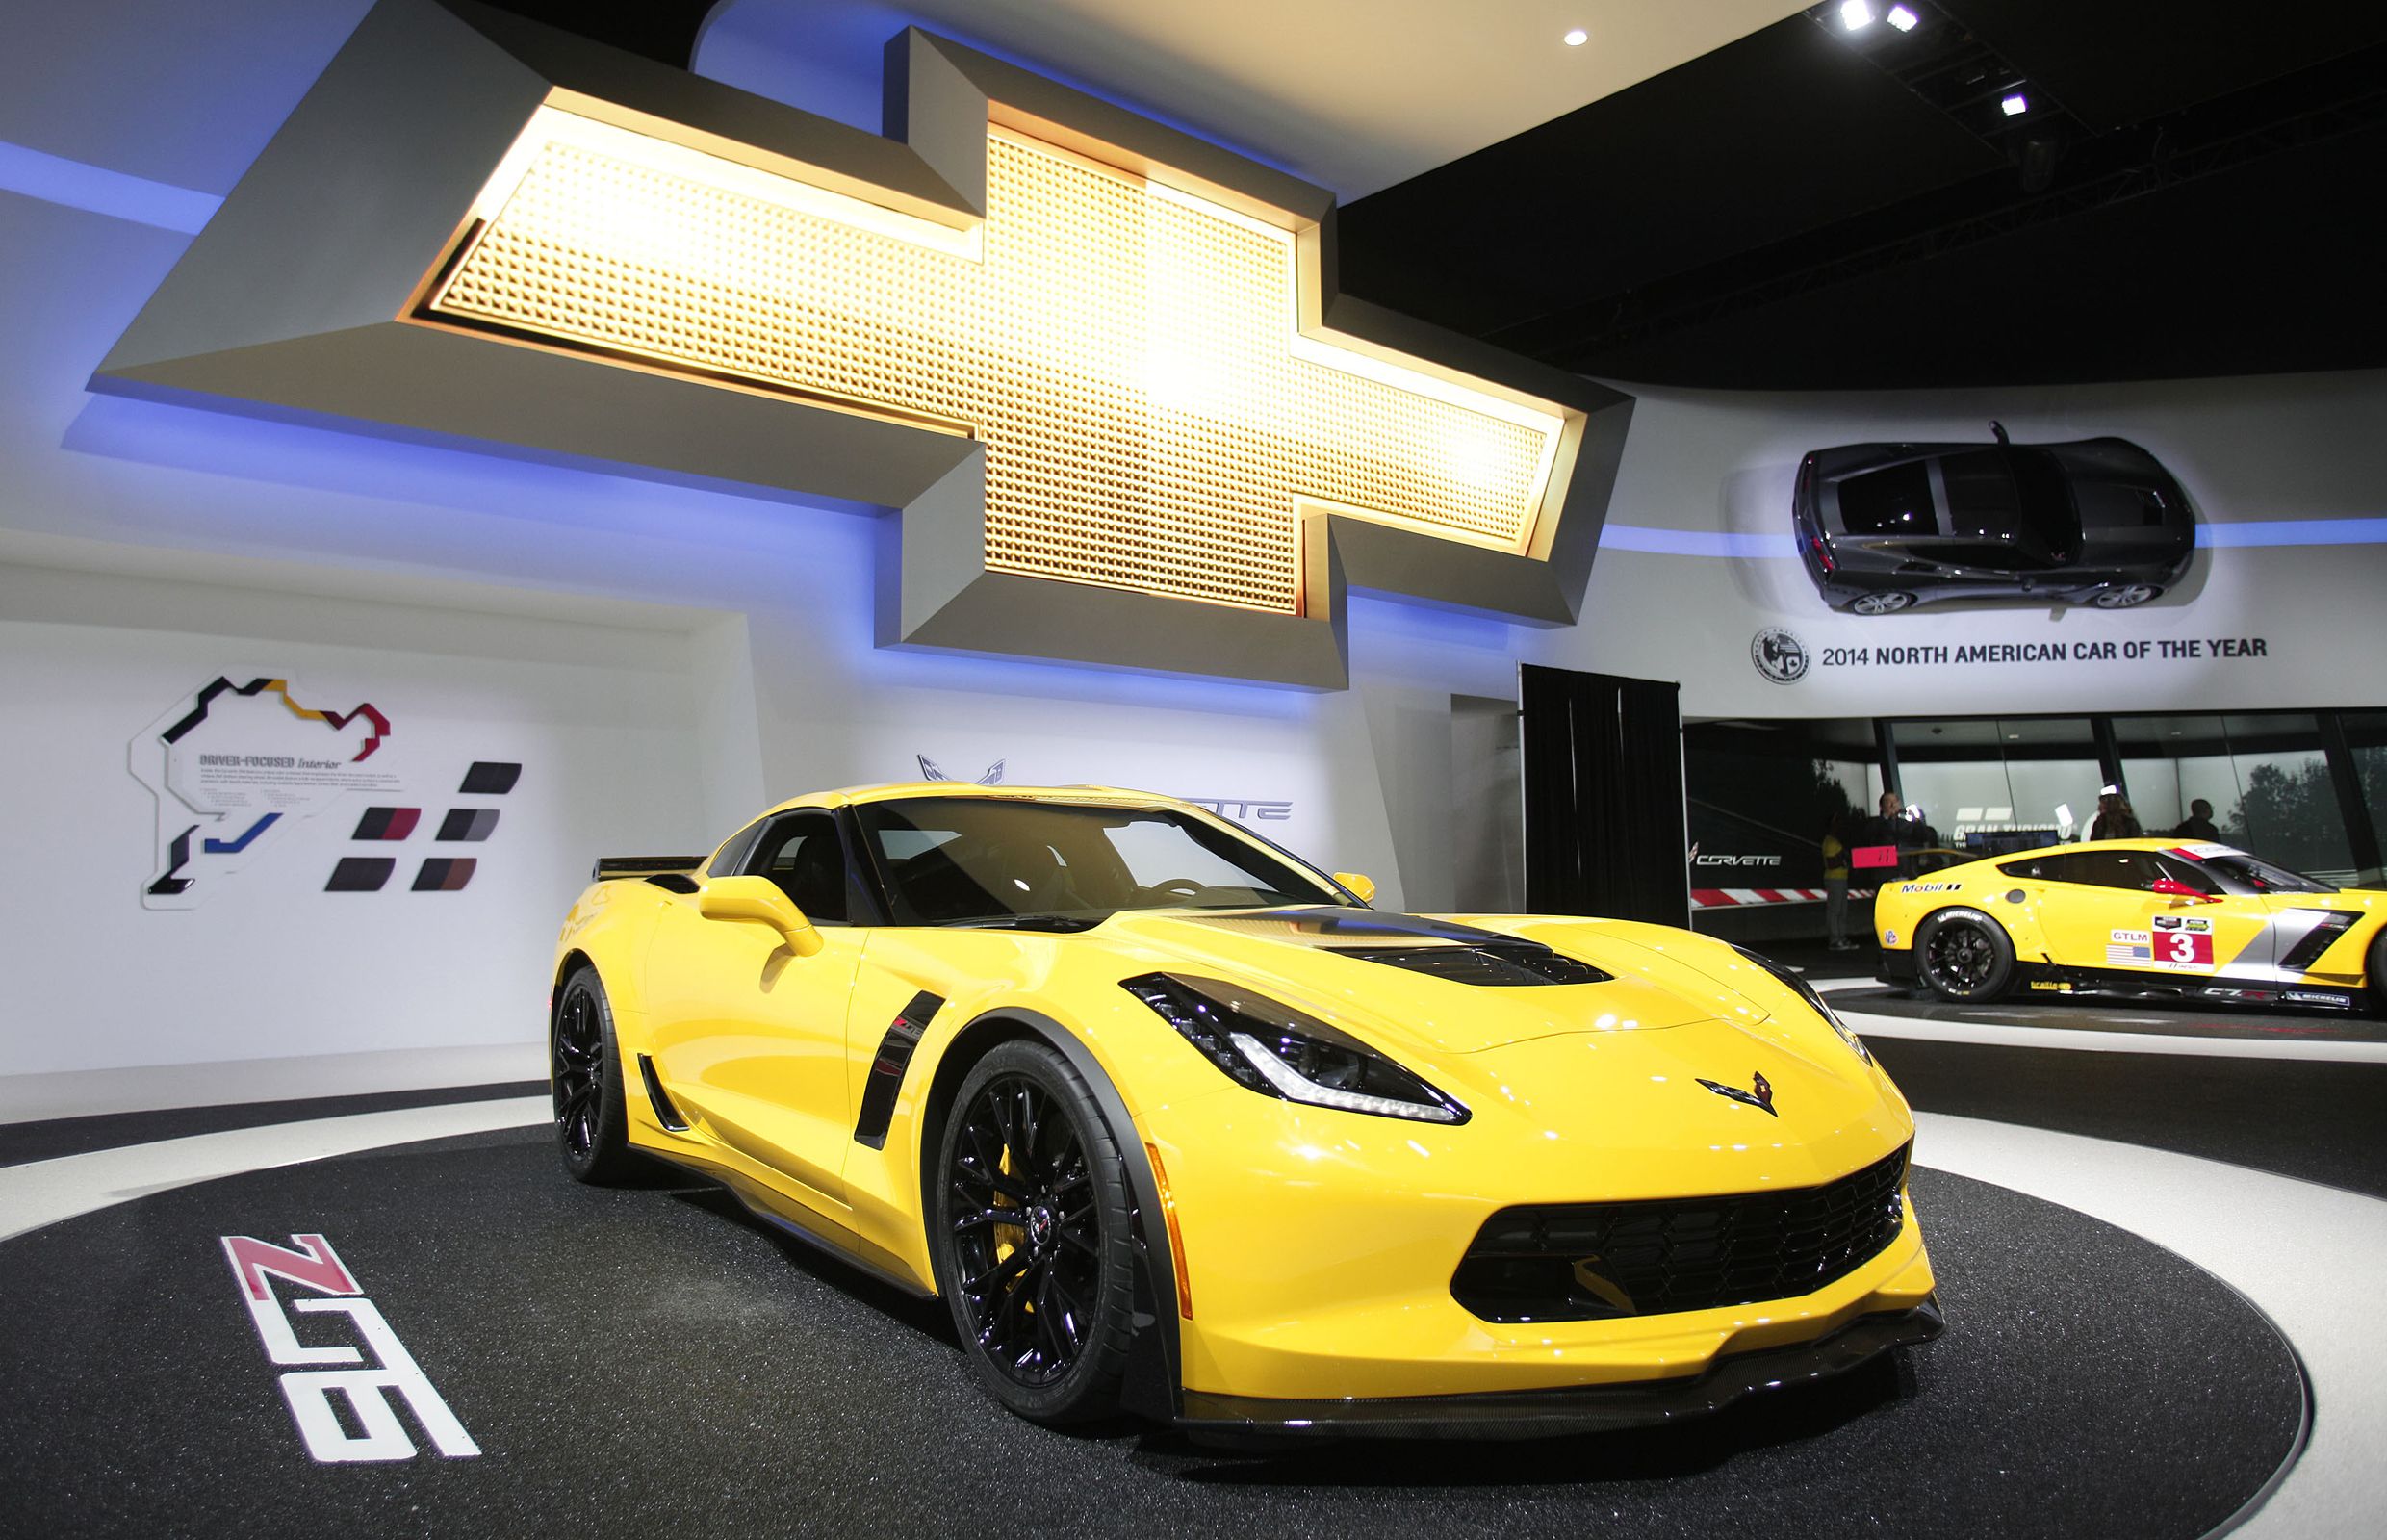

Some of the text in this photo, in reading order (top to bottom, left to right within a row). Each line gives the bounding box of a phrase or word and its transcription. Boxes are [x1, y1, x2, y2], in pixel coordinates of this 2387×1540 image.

[1822, 638, 2268, 666] 2014 NORTH AMERICAN CAR OF THE YEAR
[200, 755, 342, 769] DRIVER-FOCUSED Interior
[1696, 855, 1781, 866] CORVETTE
[1901, 884, 1943, 893] Mobil
[2113, 932, 2147, 941] GTLM
[2169, 933, 2195, 962] 3
[2302, 993, 2348, 1003] MICHELIN
